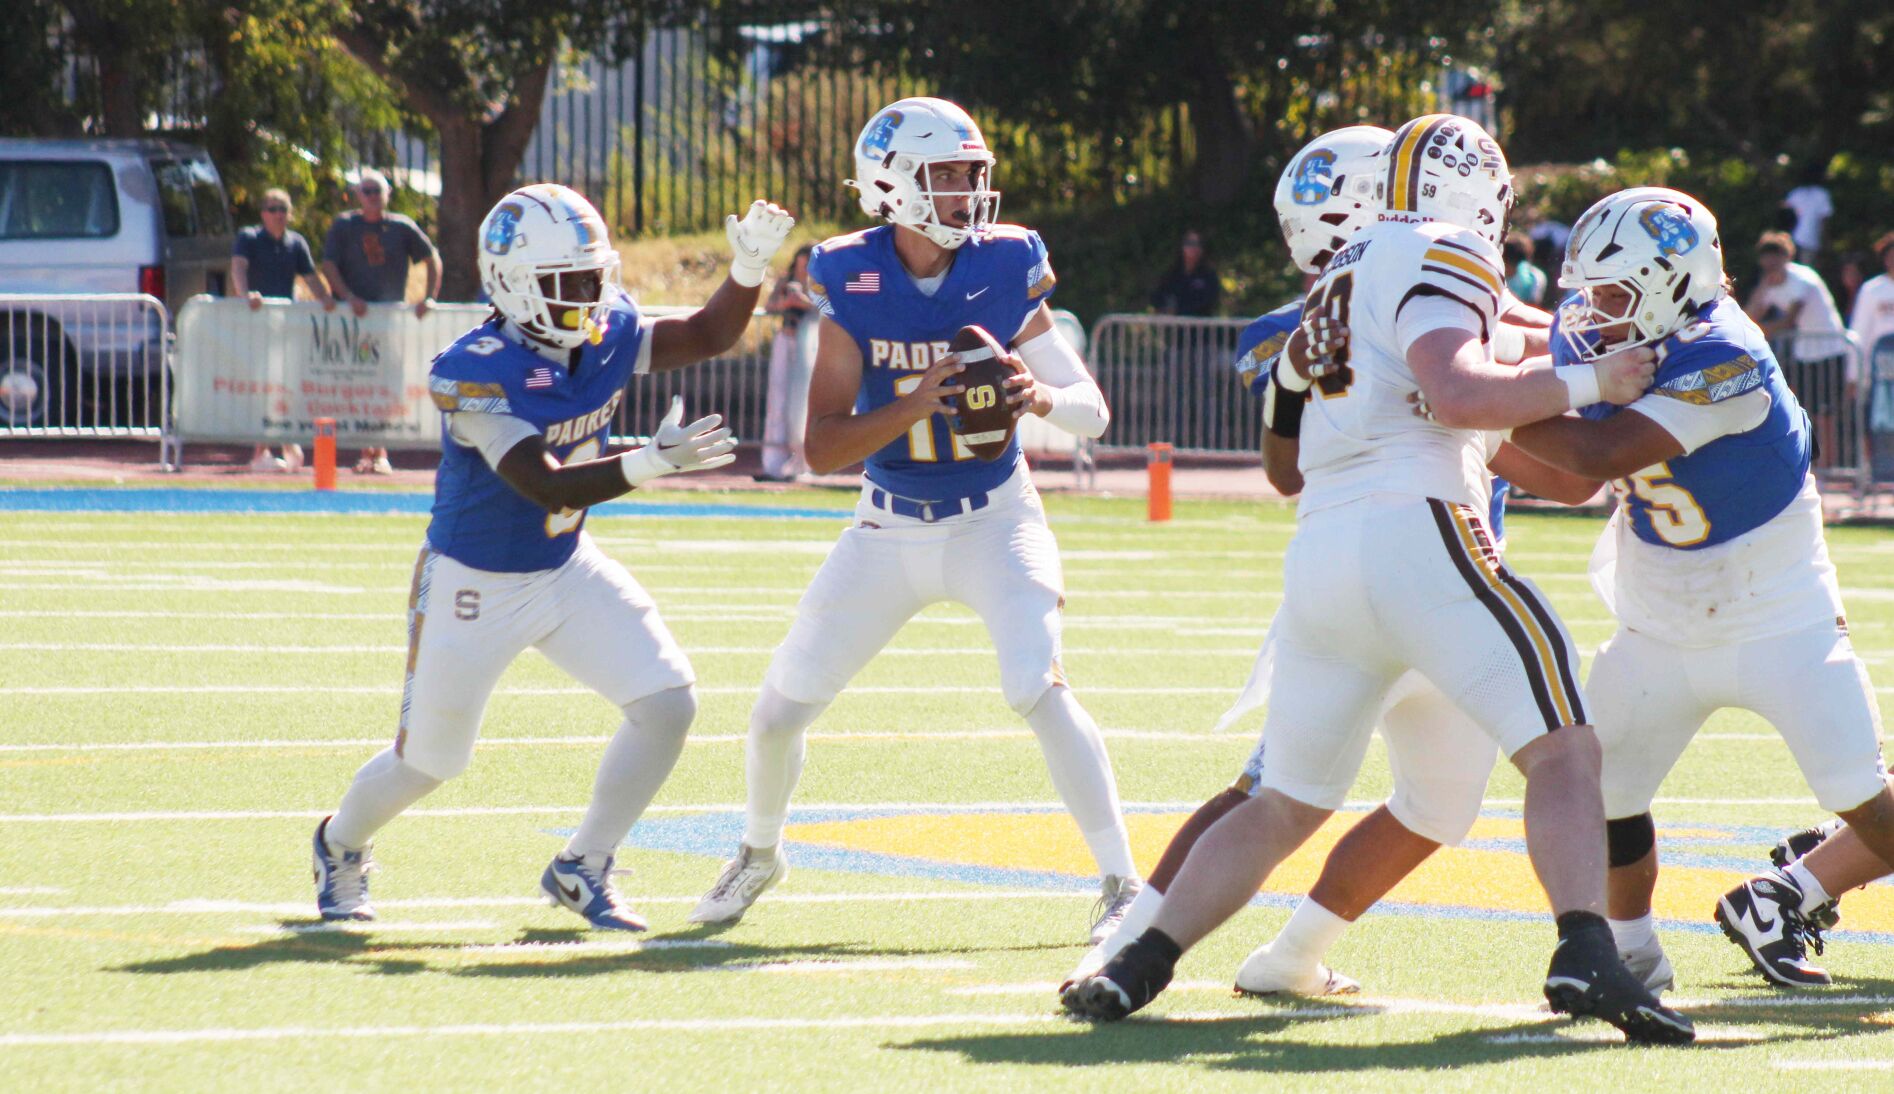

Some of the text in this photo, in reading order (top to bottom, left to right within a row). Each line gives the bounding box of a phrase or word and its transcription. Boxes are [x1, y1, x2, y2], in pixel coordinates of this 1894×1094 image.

[1422, 182, 1437, 198] 59
[466, 336, 504, 355] 3
[965, 384, 997, 409] S
[455, 589, 481, 621] S
